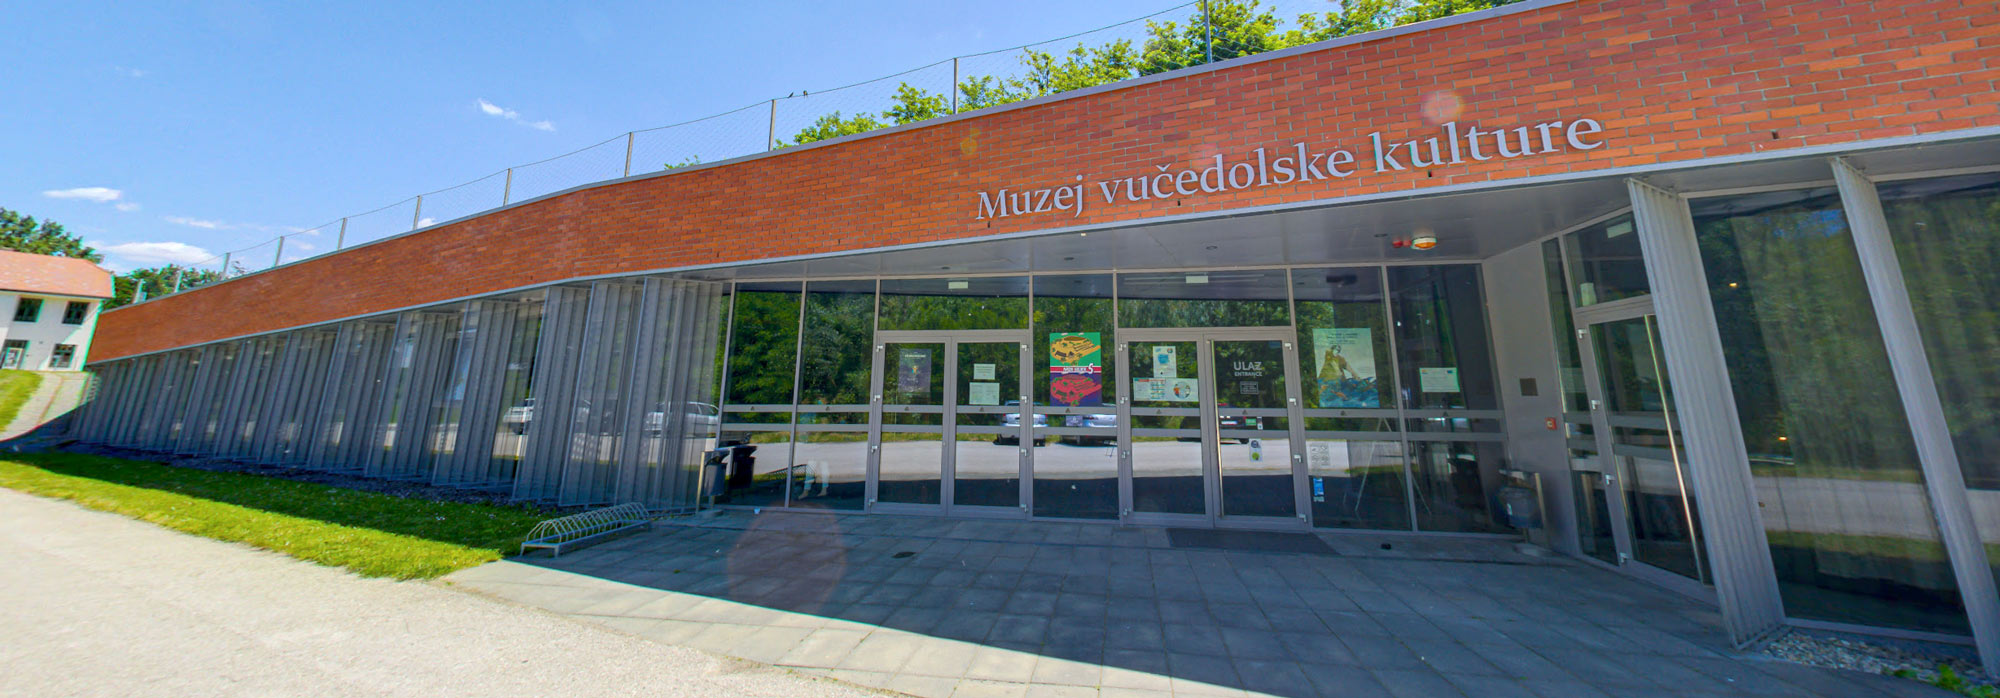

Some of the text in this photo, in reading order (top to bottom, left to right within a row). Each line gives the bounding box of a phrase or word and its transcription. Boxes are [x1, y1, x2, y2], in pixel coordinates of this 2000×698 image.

[976, 117, 1603, 220] Muzej vučedolske kulture
[1233, 361, 1262, 371] ULAZ
